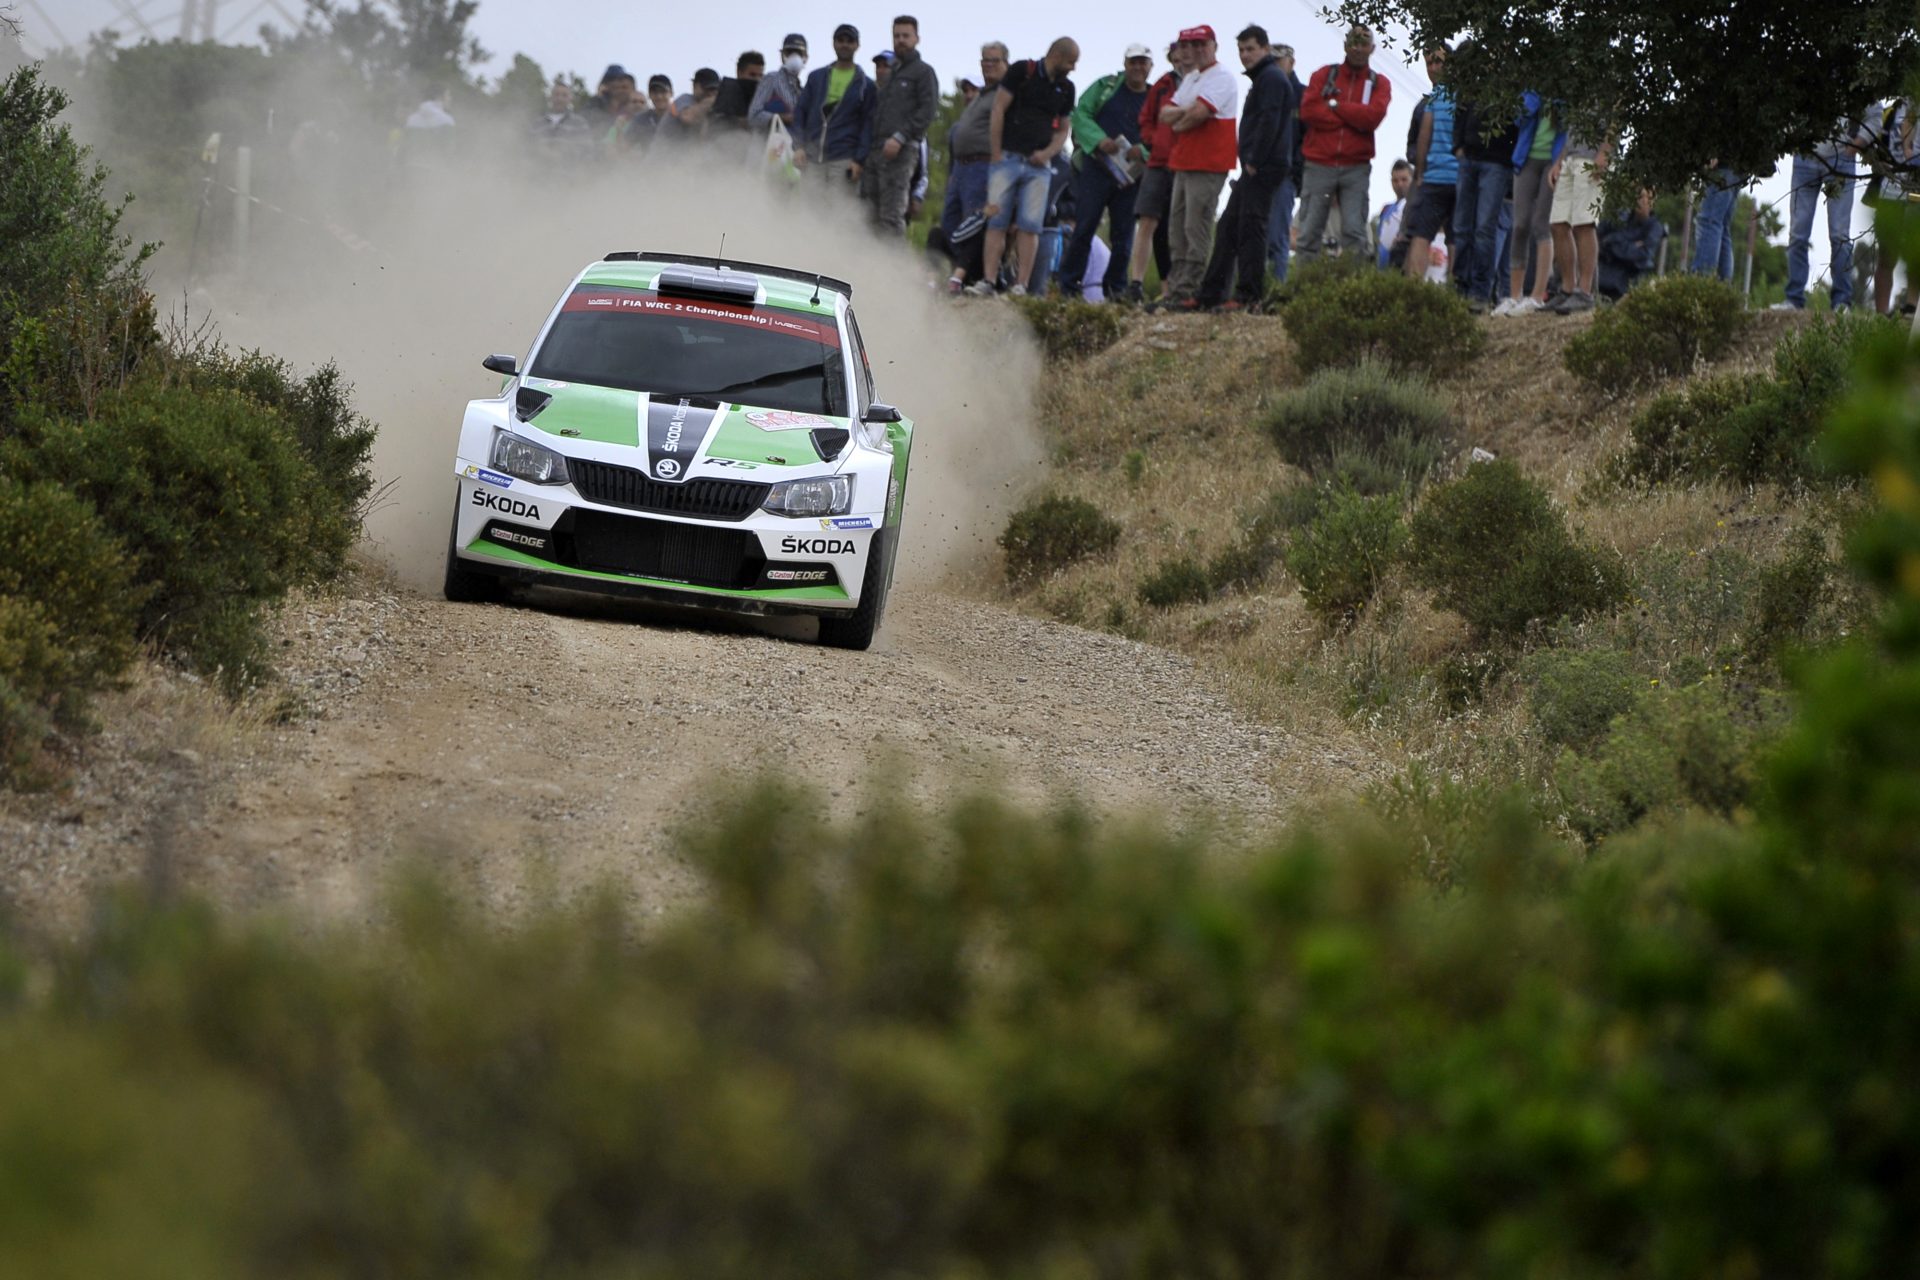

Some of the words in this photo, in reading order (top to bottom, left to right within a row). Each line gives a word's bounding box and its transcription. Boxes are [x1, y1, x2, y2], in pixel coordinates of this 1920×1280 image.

[622, 299, 642, 307] FIA
[645, 301, 671, 310] WRC
[674, 303, 683, 311] 2
[686, 305, 767, 324] Championship
[661, 421, 684, 453] ŠKODA
[702, 458, 761, 470] R5
[480, 472, 512, 485] MICHELIN
[472, 487, 541, 521] ŠKODA
[838, 519, 872, 527] MICHELIN
[512, 533, 546, 548] EDGE
[781, 535, 856, 555] ŠKODA
[794, 570, 828, 580] EDGE
